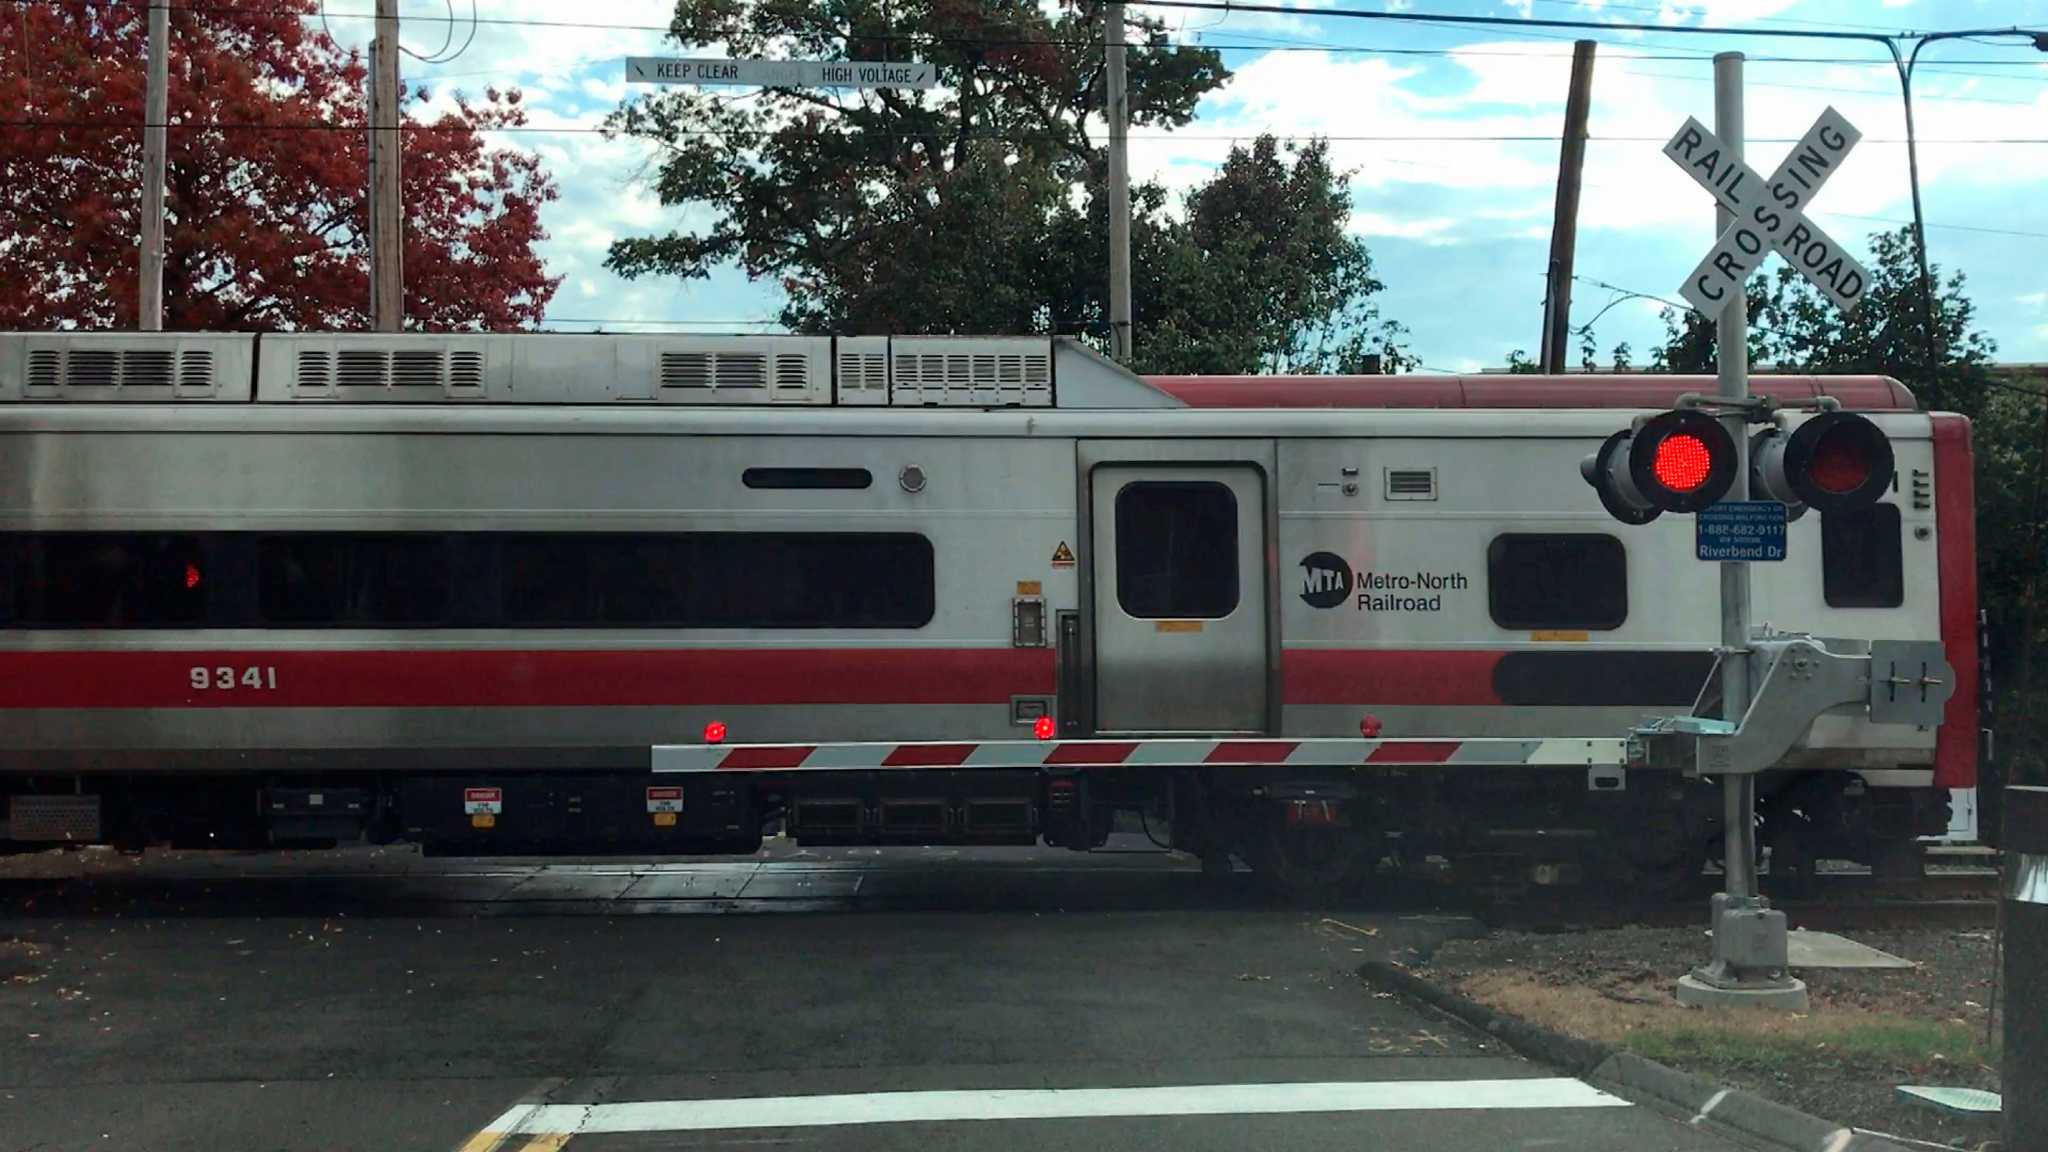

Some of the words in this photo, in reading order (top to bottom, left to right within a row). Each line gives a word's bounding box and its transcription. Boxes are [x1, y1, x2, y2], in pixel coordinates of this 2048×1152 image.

[657, 63, 690, 79] KEEP
[697, 64, 738, 80] CLEAR
[822, 67, 851, 82] HIGH
[858, 67, 912, 84] VOLTAGE
[1674, 127, 1745, 204] RAIL
[1783, 223, 1863, 299] ROAD
[1697, 126, 1846, 301] CROSSING
[1700, 545, 1763, 558] Riverbend
[1767, 545, 1782, 558] Dr
[1357, 571, 1468, 590] Metro-North
[1358, 594, 1442, 611] Railroad
[190, 666, 276, 689] 9341
